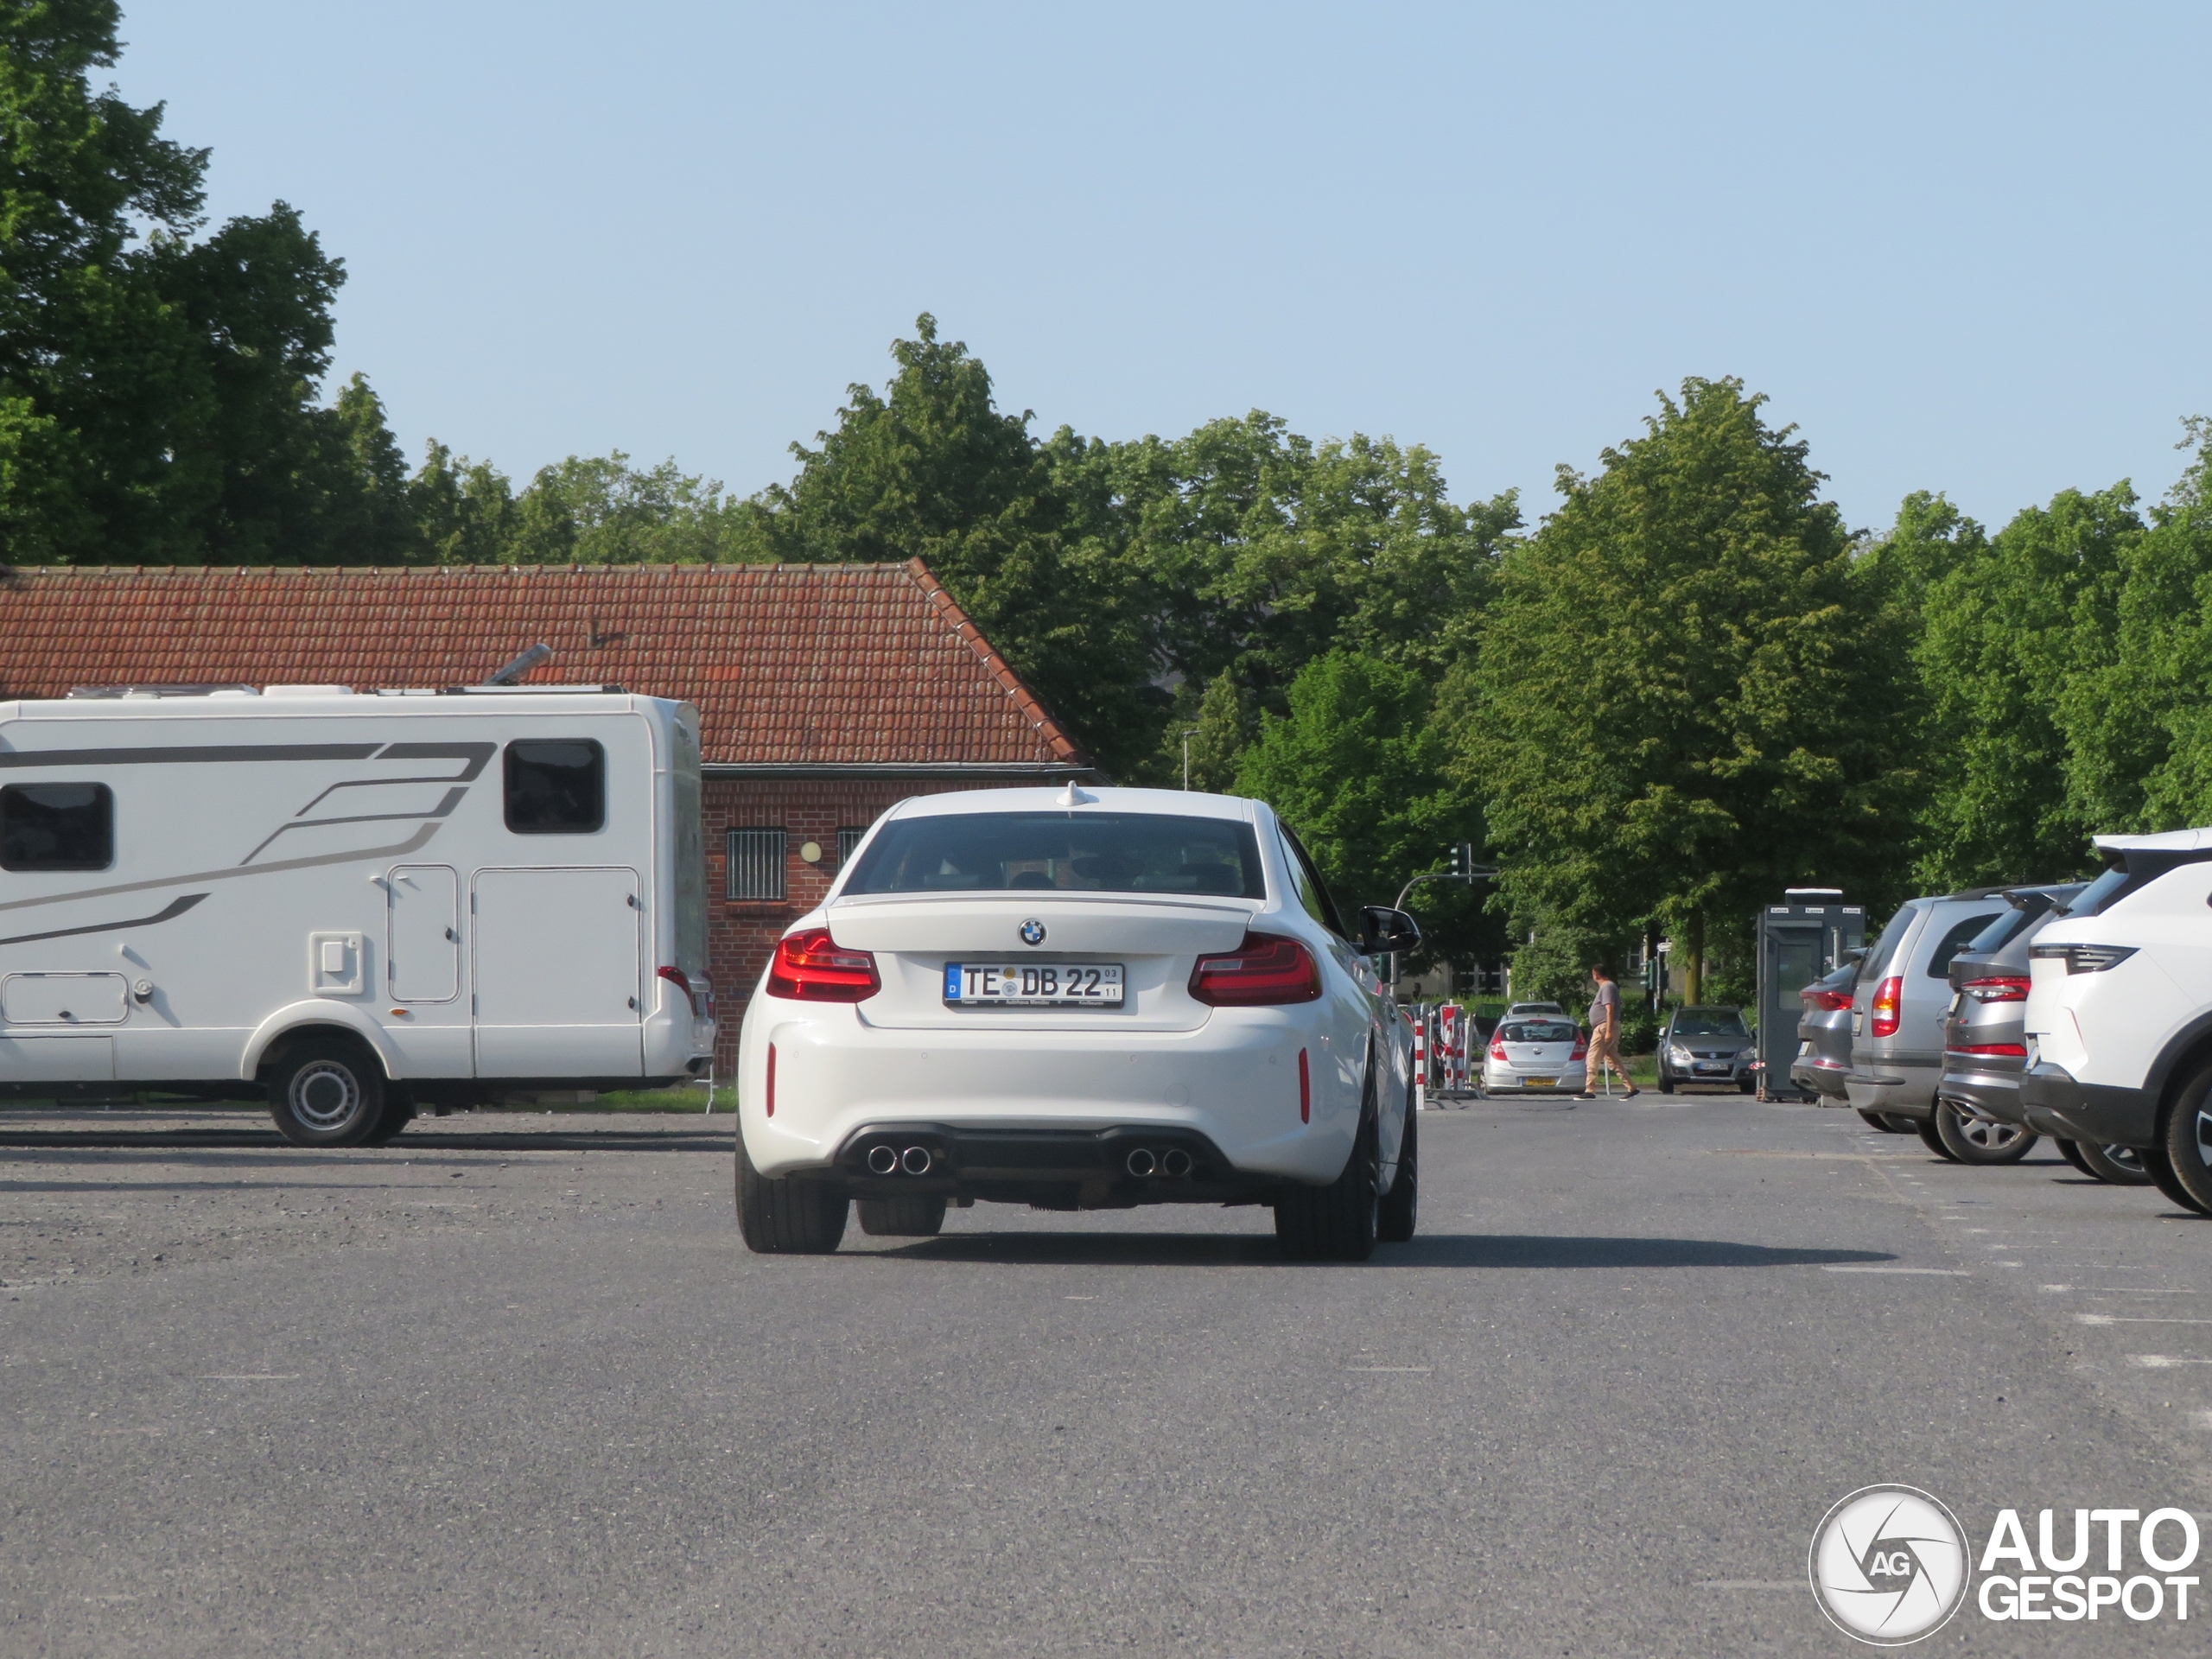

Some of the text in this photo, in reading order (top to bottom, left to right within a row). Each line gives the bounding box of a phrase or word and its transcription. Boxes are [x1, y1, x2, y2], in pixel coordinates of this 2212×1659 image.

[964, 968, 1101, 995] TE DB 22
[949, 984, 957, 993] D
[1105, 988, 1116, 996] 11
